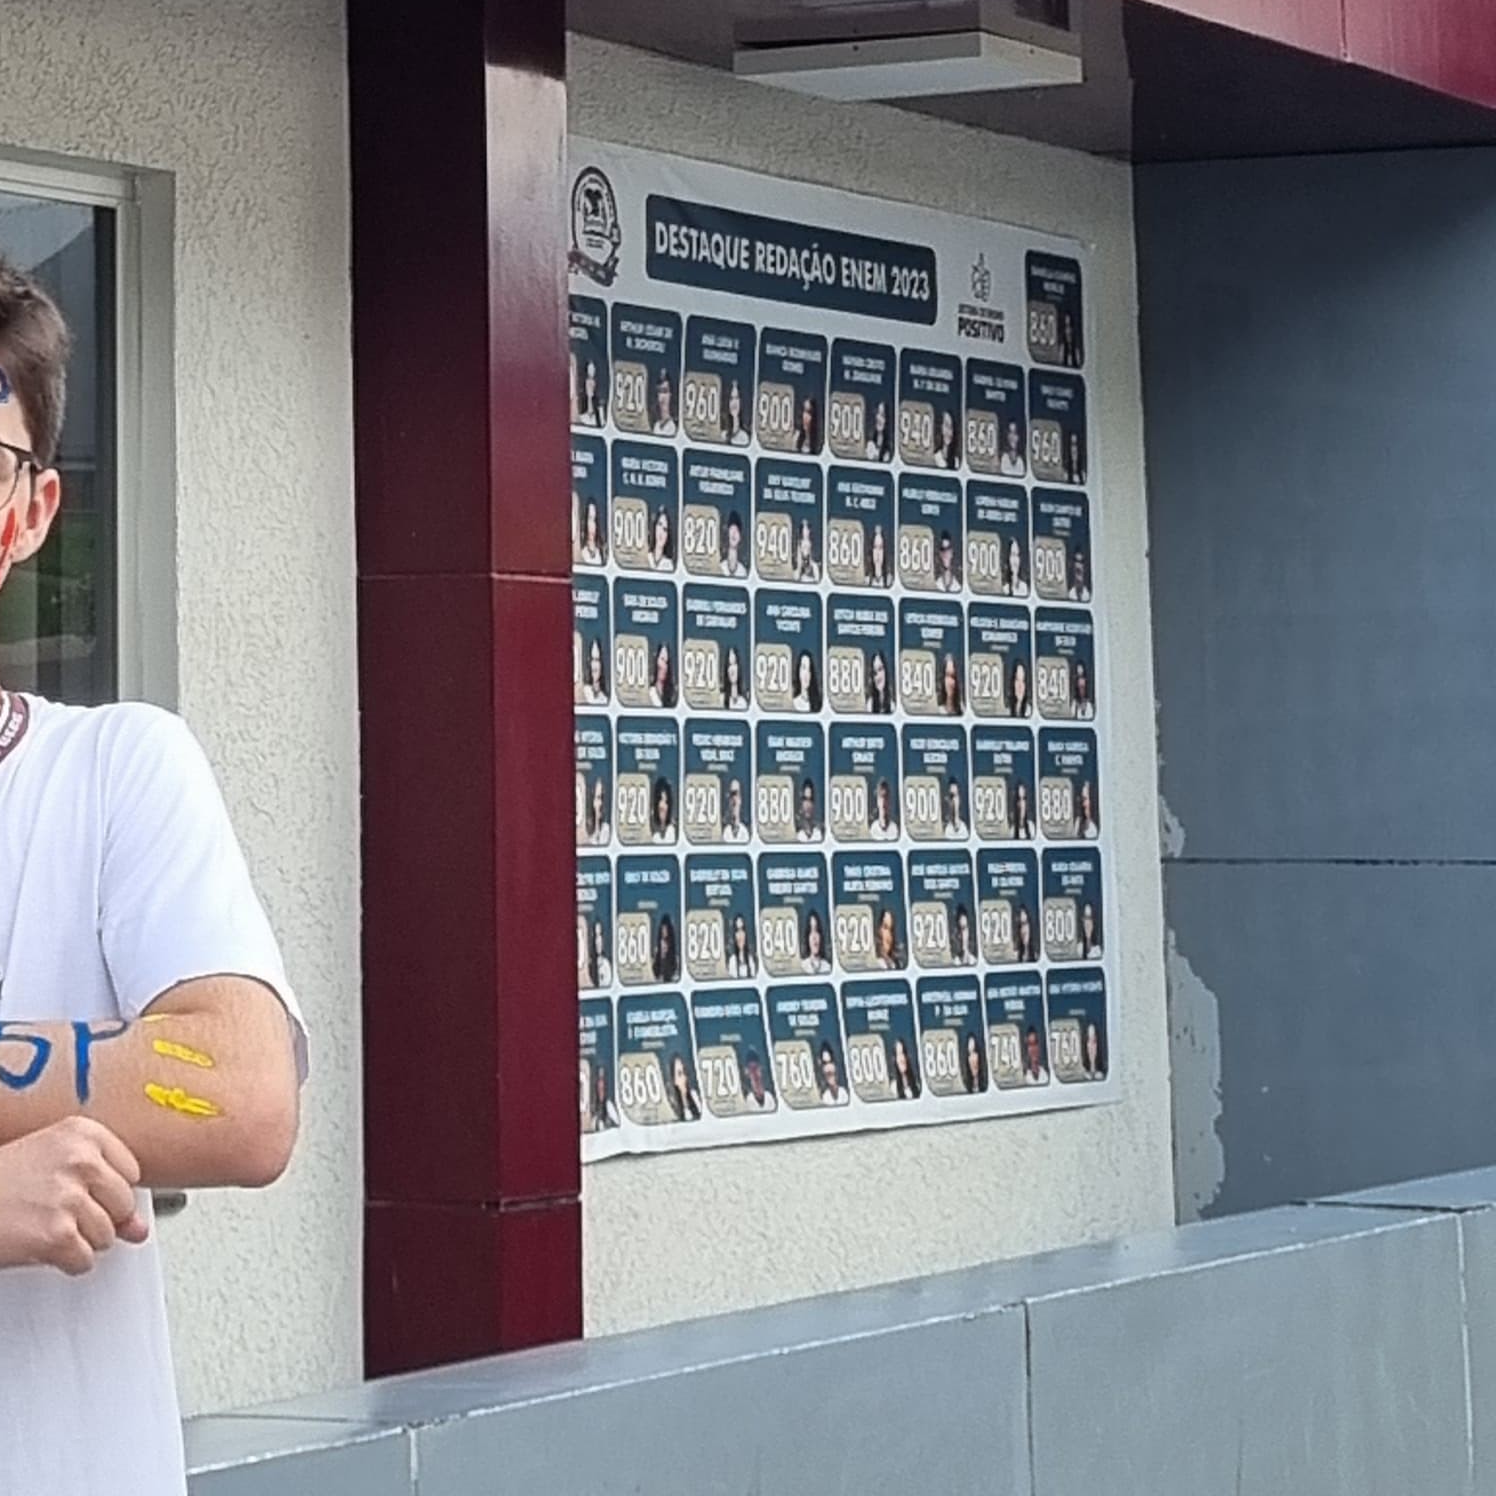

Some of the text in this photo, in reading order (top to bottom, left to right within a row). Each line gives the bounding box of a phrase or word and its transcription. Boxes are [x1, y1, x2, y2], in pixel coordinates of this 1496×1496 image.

[655, 221, 750, 270] DESTAQUE
[841, 256, 887, 293] ENEM
[891, 266, 930, 301] 2023
[958, 315, 1005, 344] POSITIVO
[616, 372, 644, 412] 920
[686, 383, 717, 422] 960
[759, 393, 791, 431] 900
[831, 402, 862, 440] 900
[900, 411, 930, 448] 940
[614, 510, 645, 548] 900
[684, 516, 716, 554] 820
[757, 524, 789, 561] 940
[829, 530, 861, 567] 860
[900, 535, 930, 571] 860
[968, 541, 999, 577] 900
[1036, 548, 1065, 582] 900
[616, 647, 645, 686] 900
[684, 652, 716, 689] 920
[757, 654, 789, 691] 920
[829, 657, 861, 694] 880
[902, 661, 933, 699] 840
[971, 663, 1001, 698] 920
[1038, 666, 1066, 701] 840
[618, 786, 647, 824] 920
[686, 787, 717, 824] 920
[758, 787, 791, 823] 880
[831, 787, 864, 822] 900
[906, 787, 938, 822] 900
[975, 787, 1005, 821] 920
[1041, 787, 1071, 821] 880
[688, 922, 720, 960] 820
[762, 919, 797, 956] 840
[837, 915, 872, 952] 920
[913, 913, 946, 948] 920
[981, 911, 1011, 944] 920
[1045, 909, 1075, 942] 800
[618, 925, 648, 964] 860
[775, 1051, 813, 1088] 760
[850, 1046, 885, 1084] 800
[924, 1040, 959, 1077] 860
[620, 1064, 660, 1105] 860
[701, 1058, 739, 1097] 720
